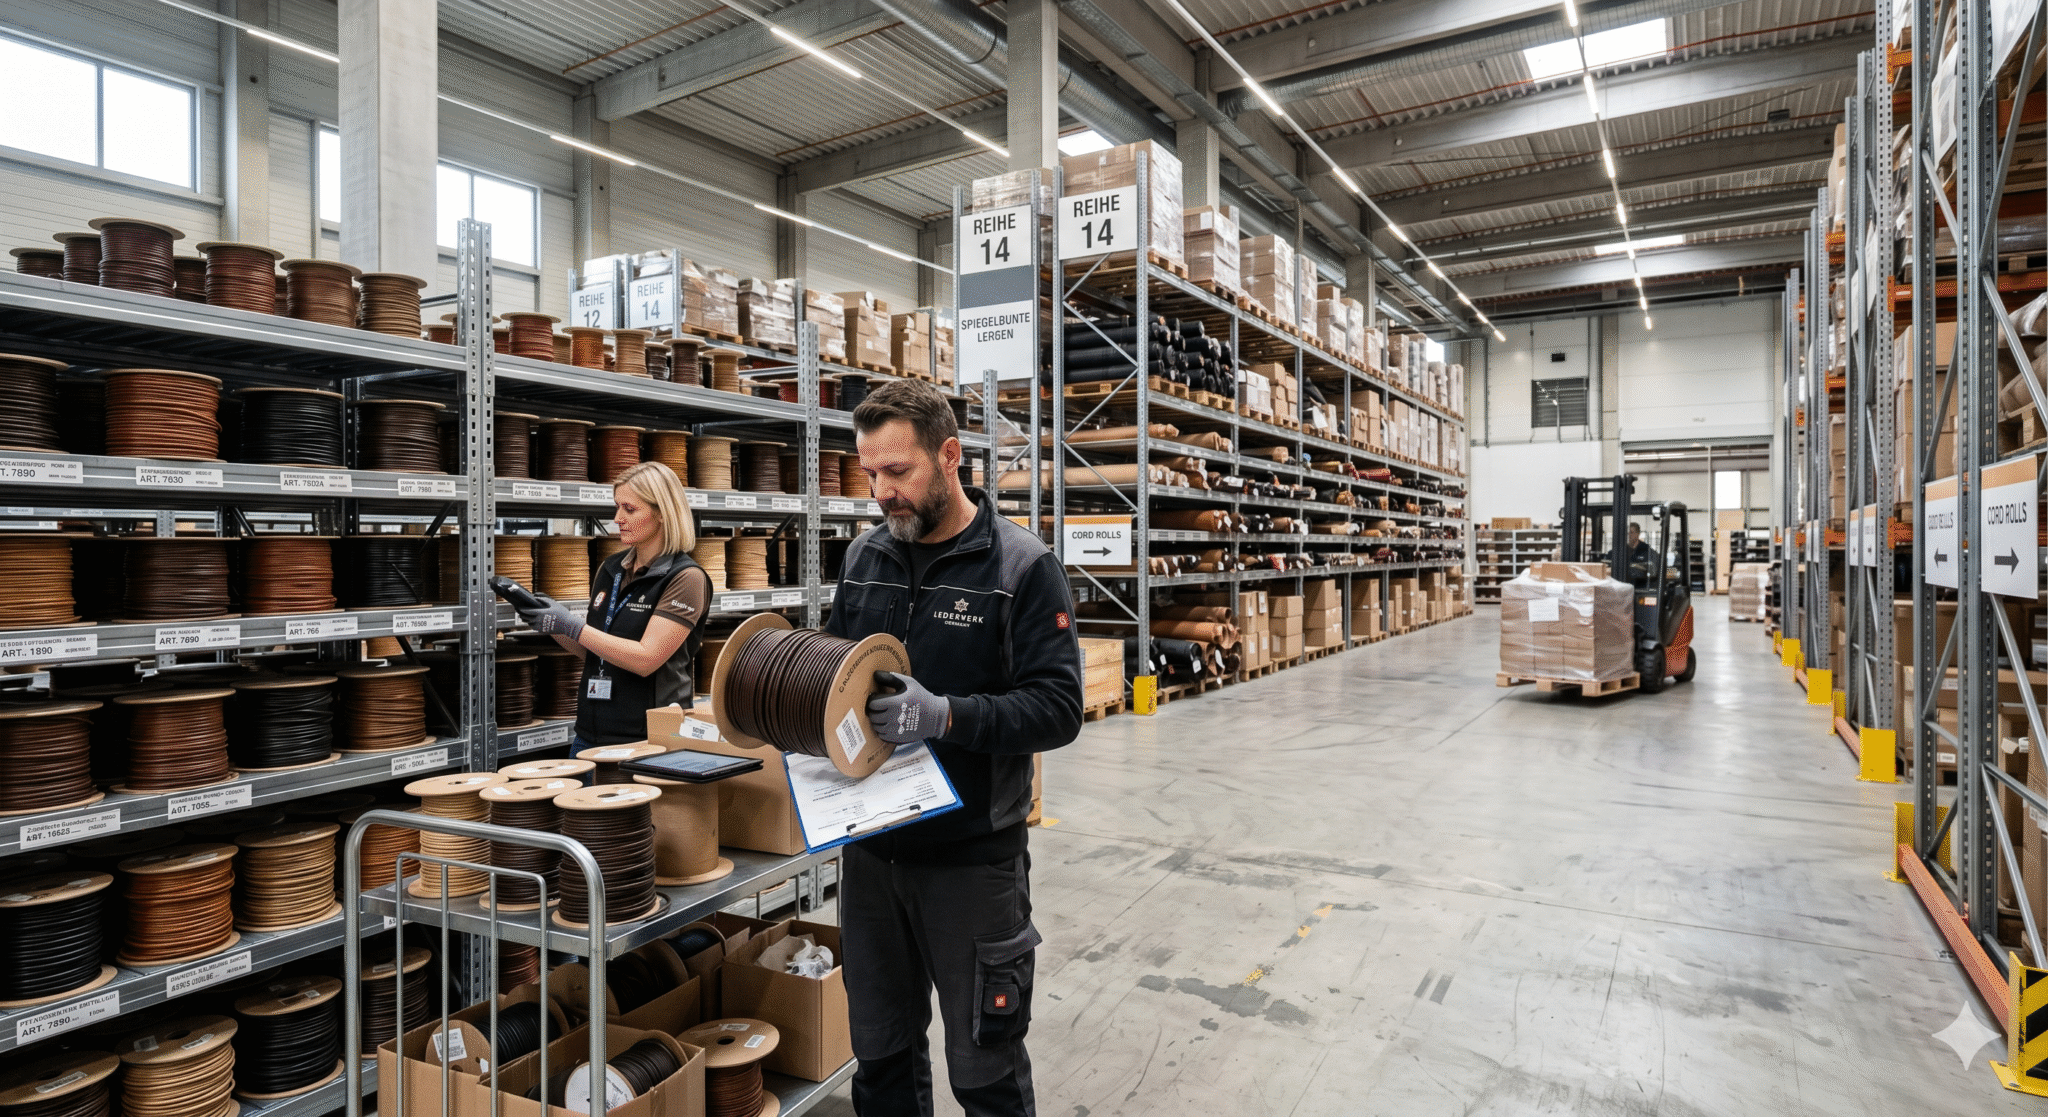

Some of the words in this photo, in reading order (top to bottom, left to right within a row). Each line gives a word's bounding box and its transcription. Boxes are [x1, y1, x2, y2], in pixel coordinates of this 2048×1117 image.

[1073, 194, 1120, 218] REIHE
[973, 213, 1016, 235] REIHE
[1081, 218, 1114, 249] 14
[980, 236, 1010, 265] 14
[637, 282, 664, 297] REIHE
[579, 292, 605, 308] REIHE
[584, 309, 600, 328] 12
[642, 300, 660, 321] 14
[961, 312, 1031, 330] SPIEGELBUNTE
[11, 468, 36, 478] 7890
[140, 474, 160, 483] ART.
[283, 479, 301, 487] ART.
[1988, 504, 2004, 526] CORD
[2005, 501, 2027, 524] ROLLS
[1072, 531, 1094, 540] CORD
[1096, 530, 1122, 540] ROLLS
[288, 628, 305, 636] ART.
[159, 637, 178, 645] ART.
[30, 646, 53, 656] 1890
[21, 1024, 45, 1038] ART.
[47, 1016, 70, 1030] 7890
